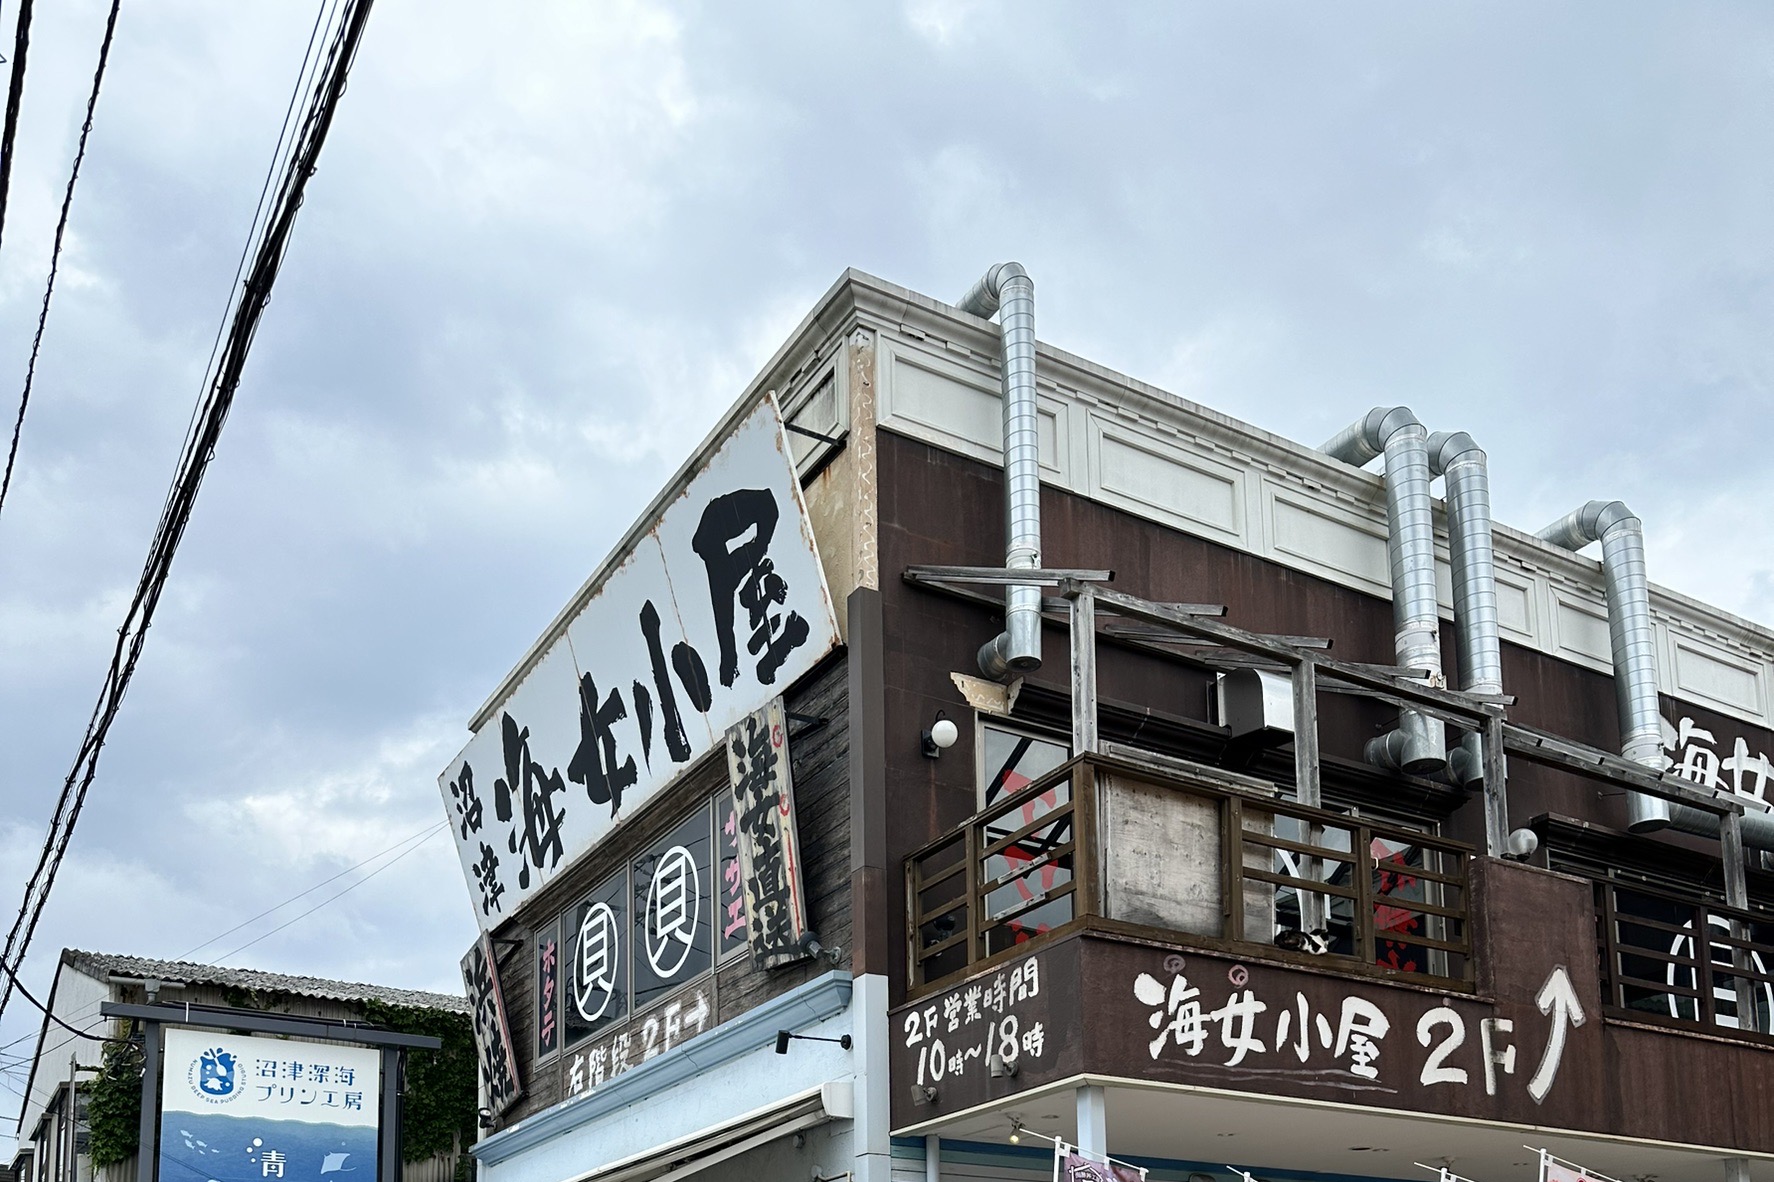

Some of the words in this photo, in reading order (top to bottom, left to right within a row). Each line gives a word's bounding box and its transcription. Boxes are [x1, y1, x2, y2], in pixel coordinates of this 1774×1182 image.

[495, 488, 810, 889] 海女小屋
[449, 759, 502, 917] 沼津
[542, 938, 555, 1047] ホタテ
[1133, 971, 1392, 1079] 海女小屋
[1416, 1006, 1517, 1096] 2F
[256, 1058, 356, 1086] 沼津深海
[256, 1083, 364, 1111] プリン工房
